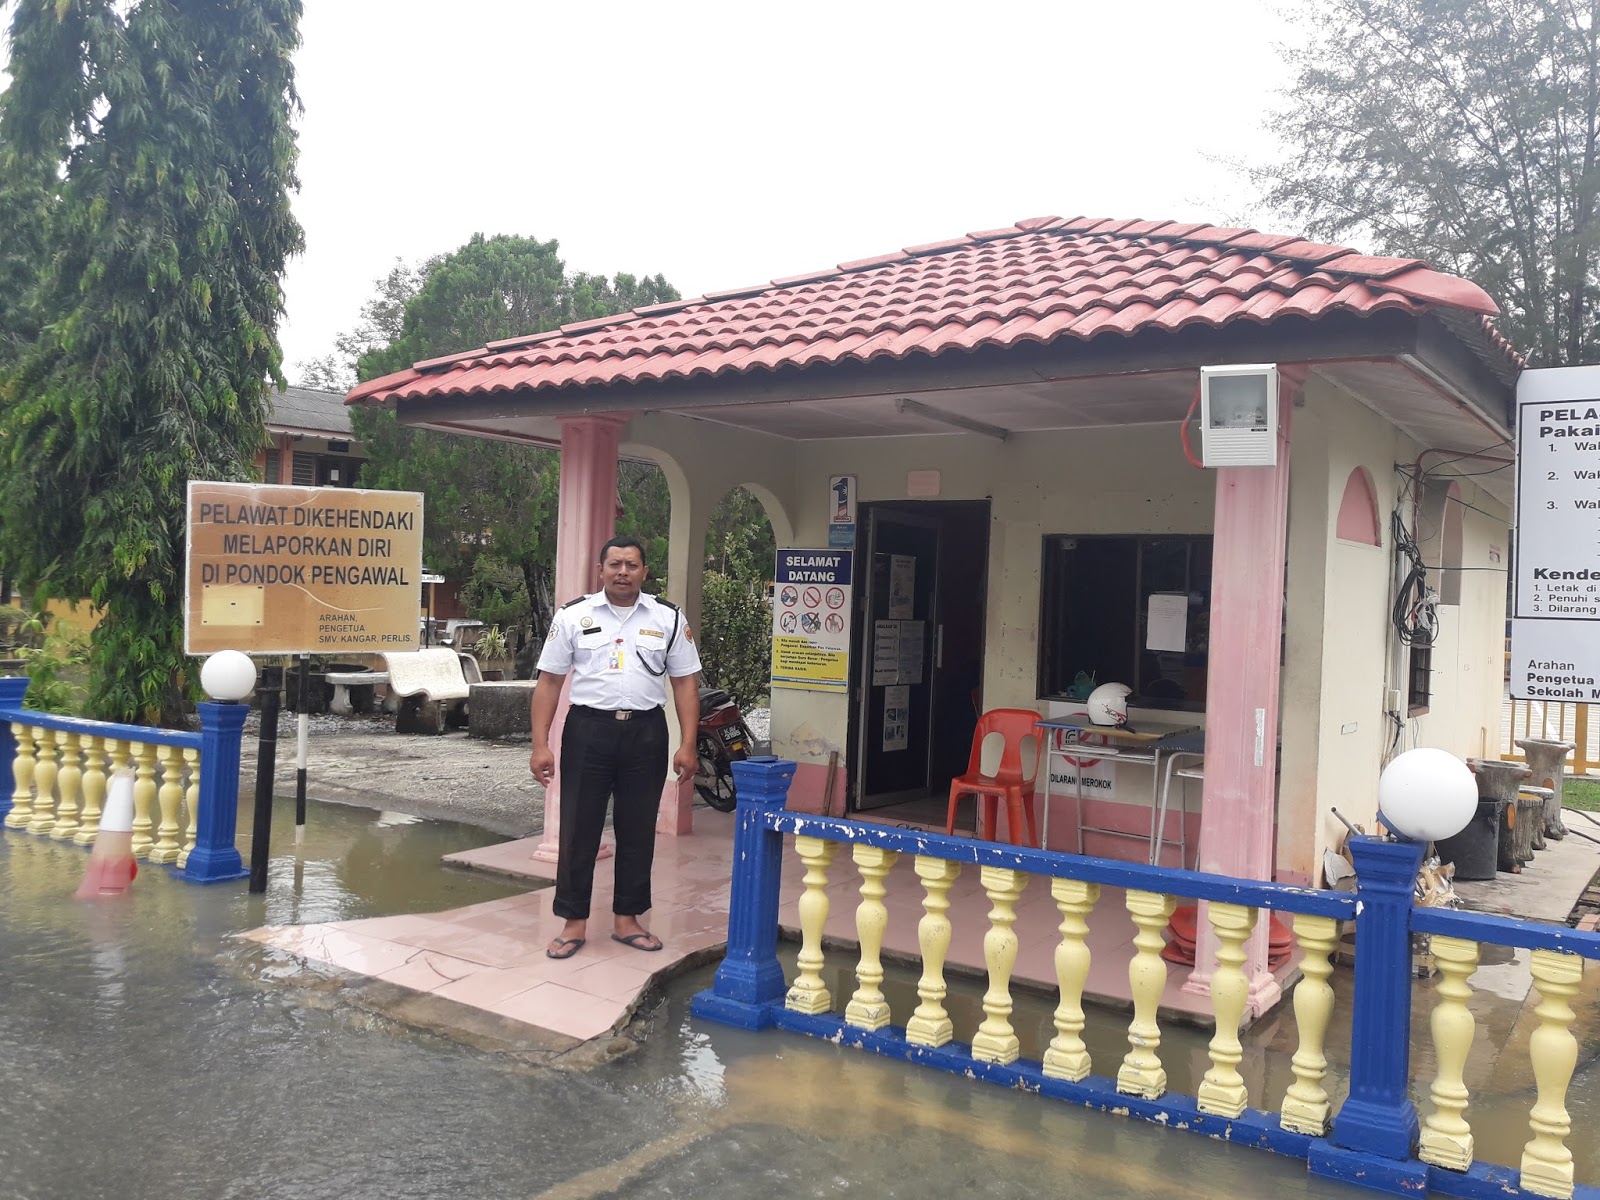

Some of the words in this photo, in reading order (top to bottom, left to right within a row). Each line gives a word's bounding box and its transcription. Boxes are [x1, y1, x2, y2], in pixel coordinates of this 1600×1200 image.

[1540, 408, 1600, 421] PELA
[1540, 424, 1600, 438] Pakai
[1549, 443, 1557, 452] 1.
[1547, 471, 1559, 481] 2.
[1546, 501, 1559, 510] 3.
[200, 503, 288, 526] PELAWAT
[294, 507, 414, 530] DIKEHENDAKI
[223, 534, 352, 557] MELAPORKAN
[358, 538, 391, 558] DIRI
[786, 556, 841, 568] SELAMAT
[202, 563, 220, 583] DI
[226, 564, 306, 585] PONDOK
[312, 566, 409, 586] PENGAWAL
[788, 570, 836, 582] DATANG
[1533, 567, 1600, 580] Kende
[1534, 584, 1541, 592] 1.
[1547, 584, 1579, 592] Letak
[1586, 584, 1597, 592] di
[1533, 594, 1543, 602] 2.
[1549, 594, 1588, 603] Penuhi
[1533, 604, 1543, 612] 3.
[1548, 604, 1597, 615] Dilarang
[319, 614, 358, 623] ARAHAN,
[319, 624, 365, 633] PENGETUA
[340, 634, 379, 644] KANGAR,
[381, 634, 413, 643] PERLIS.
[1527, 659, 1575, 671] Arahan
[1526, 672, 1595, 686] Pengetua
[1526, 685, 1584, 698] Sekolah
[1050, 773, 1078, 785] DILARAN
[1081, 777, 1112, 790] MEROKOK
